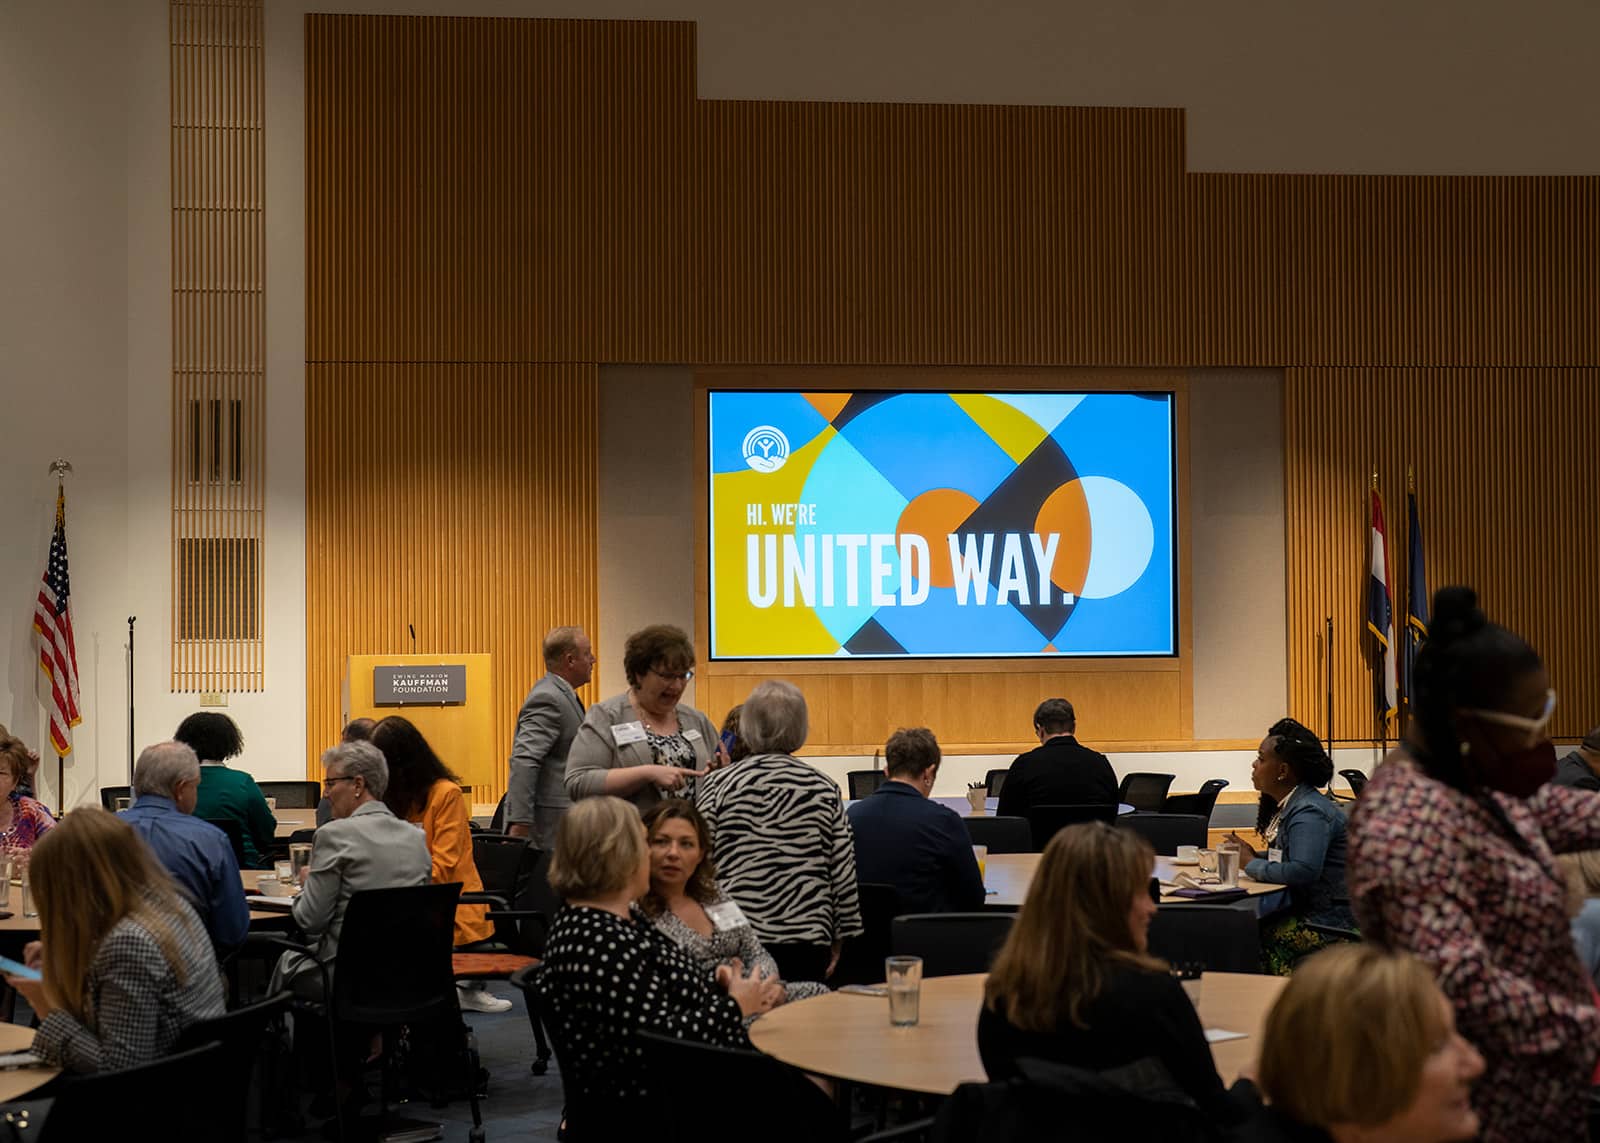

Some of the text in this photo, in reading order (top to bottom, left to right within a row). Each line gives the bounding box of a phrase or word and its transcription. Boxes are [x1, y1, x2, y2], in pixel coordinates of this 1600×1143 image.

[747, 504, 767, 525] HI.
[747, 533, 1075, 608] UNITED WAY.
[392, 679, 448, 687] KAUFFMAN
